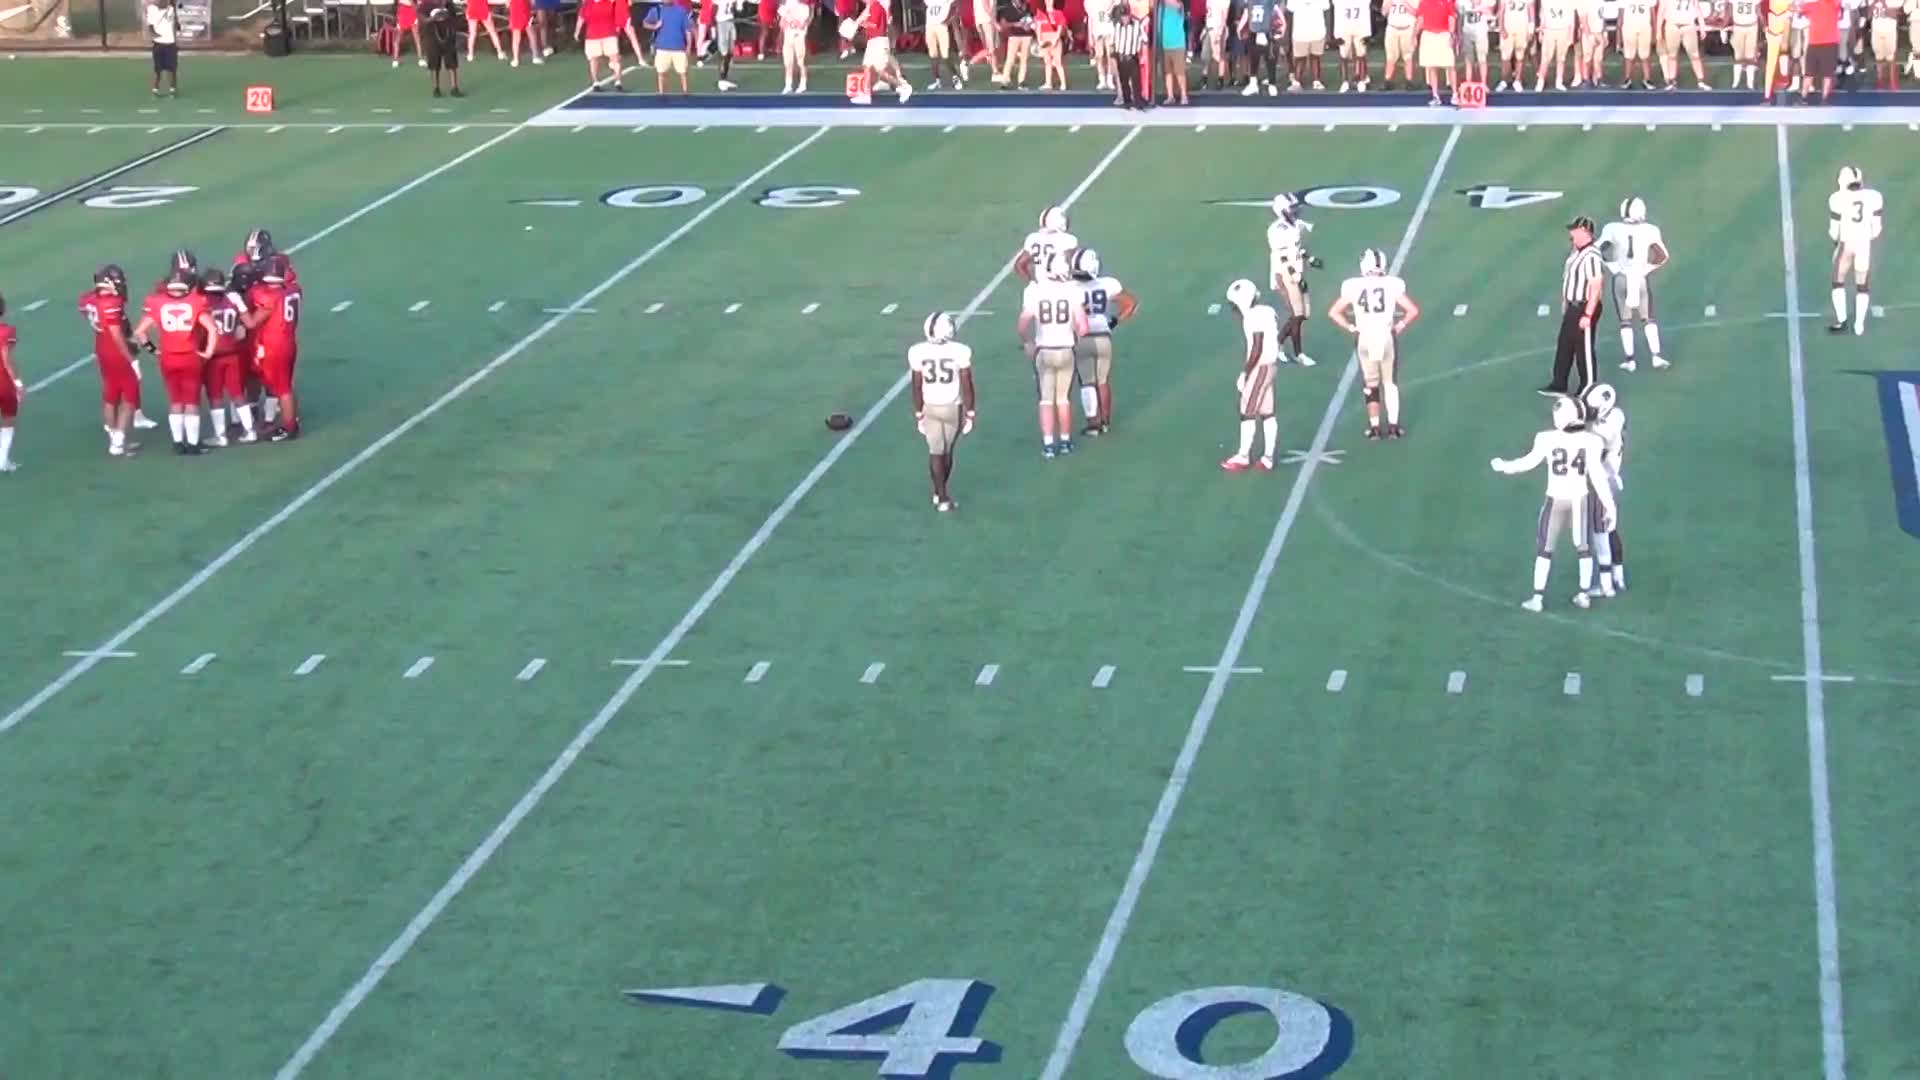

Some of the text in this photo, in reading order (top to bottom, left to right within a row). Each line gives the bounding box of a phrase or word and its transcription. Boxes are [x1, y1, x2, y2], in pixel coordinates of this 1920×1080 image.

[251, 90, 270, 107] 20
[1463, 86, 1483, 103] 40
[1851, 201, 1864, 222] 3
[1626, 235, 1634, 259] 1
[1039, 299, 1070, 324] 88
[1358, 288, 1386, 312] 43
[160, 302, 193, 332] 62
[921, 359, 953, 384] 35
[1551, 447, 1587, 476] 24
